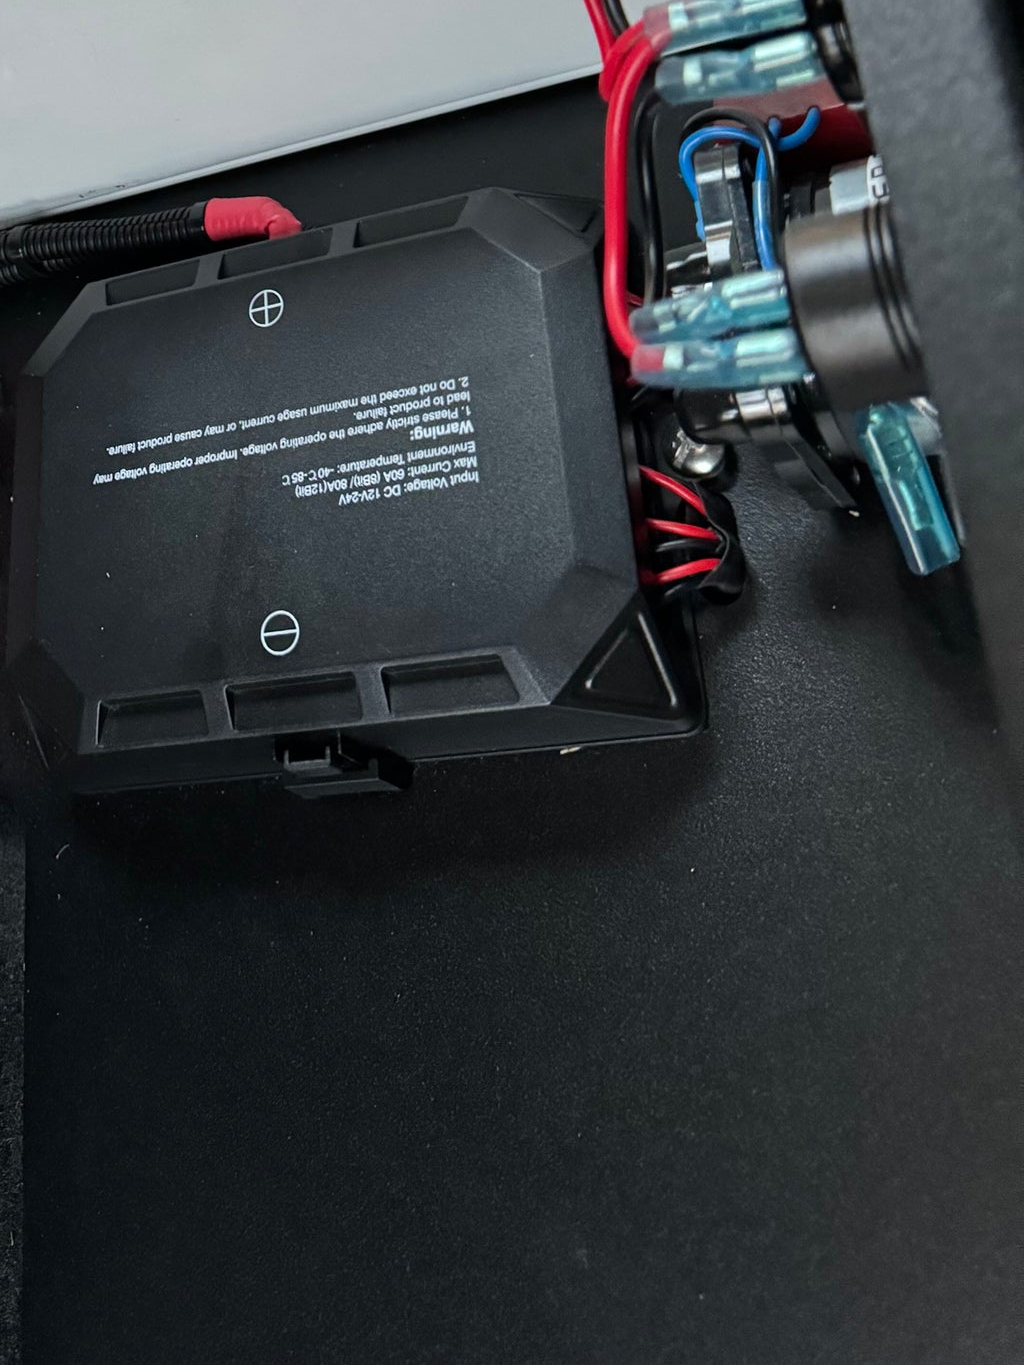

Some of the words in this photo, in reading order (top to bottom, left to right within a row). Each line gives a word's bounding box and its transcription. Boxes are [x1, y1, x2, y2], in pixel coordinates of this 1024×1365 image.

[419, 382, 437, 396] not
[439, 378, 456, 391] Do
[458, 376, 469, 388] 2.
[360, 394, 378, 406] the
[379, 386, 418, 404] exceed
[432, 395, 445, 406] to
[446, 390, 471, 406] lead
[309, 397, 359, 416] maximum
[389, 395, 431, 416] product
[461, 405, 472, 416] 1.
[276, 407, 308, 422] usage
[353, 406, 388, 421] failure.
[421, 407, 459, 423] Please
[225, 422, 237, 432] or
[238, 414, 276, 431] current,
[347, 421, 384, 436] adhere
[385, 414, 420, 430] strictly
[174, 429, 203, 443] cause
[203, 424, 225, 437] may
[328, 428, 346, 440] the
[409, 419, 474, 441] Warning:
[137, 432, 173, 451] product
[279, 430, 327, 449] operating
[106, 442, 136, 456] failure.
[239, 441, 279, 457] voltage.
[406, 440, 476, 463] Environment
[148, 456, 194, 474] operating
[193, 449, 238, 466] Improper
[337, 453, 406, 474] Temperature:
[453, 455, 478, 469] Max
[114, 466, 148, 481] voltage
[382, 468, 405, 483] 60A
[407, 460, 452, 478] Current:
[92, 473, 114, 485] may
[403, 476, 448, 492] Voltage:
[449, 469, 480, 486] Input
[338, 487, 381, 506] 12V-24V
[383, 484, 401, 498] DC
